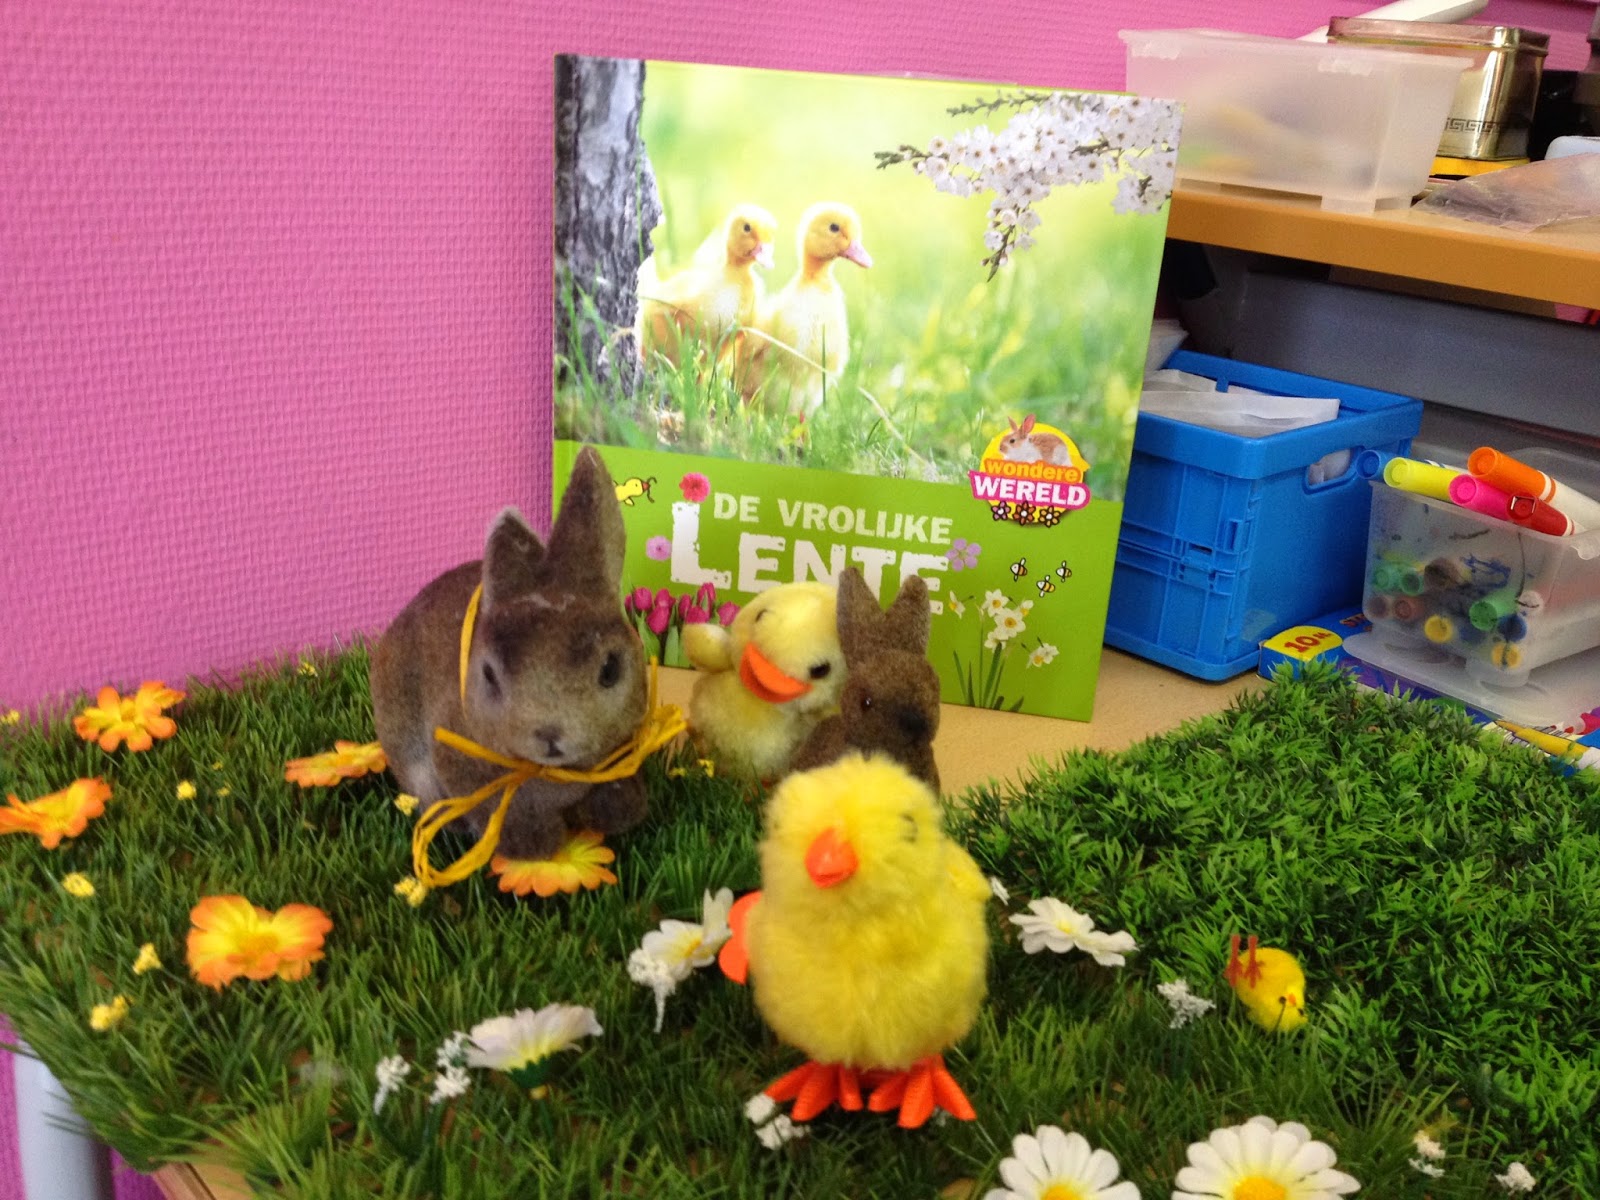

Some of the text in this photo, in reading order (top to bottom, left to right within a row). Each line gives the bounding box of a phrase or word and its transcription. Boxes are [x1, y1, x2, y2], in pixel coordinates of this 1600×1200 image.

[974, 475, 1087, 506] WERELD
[985, 460, 1080, 482] wondere
[713, 492, 953, 545] DE VROLIJKE
[670, 501, 949, 615] LENTE
